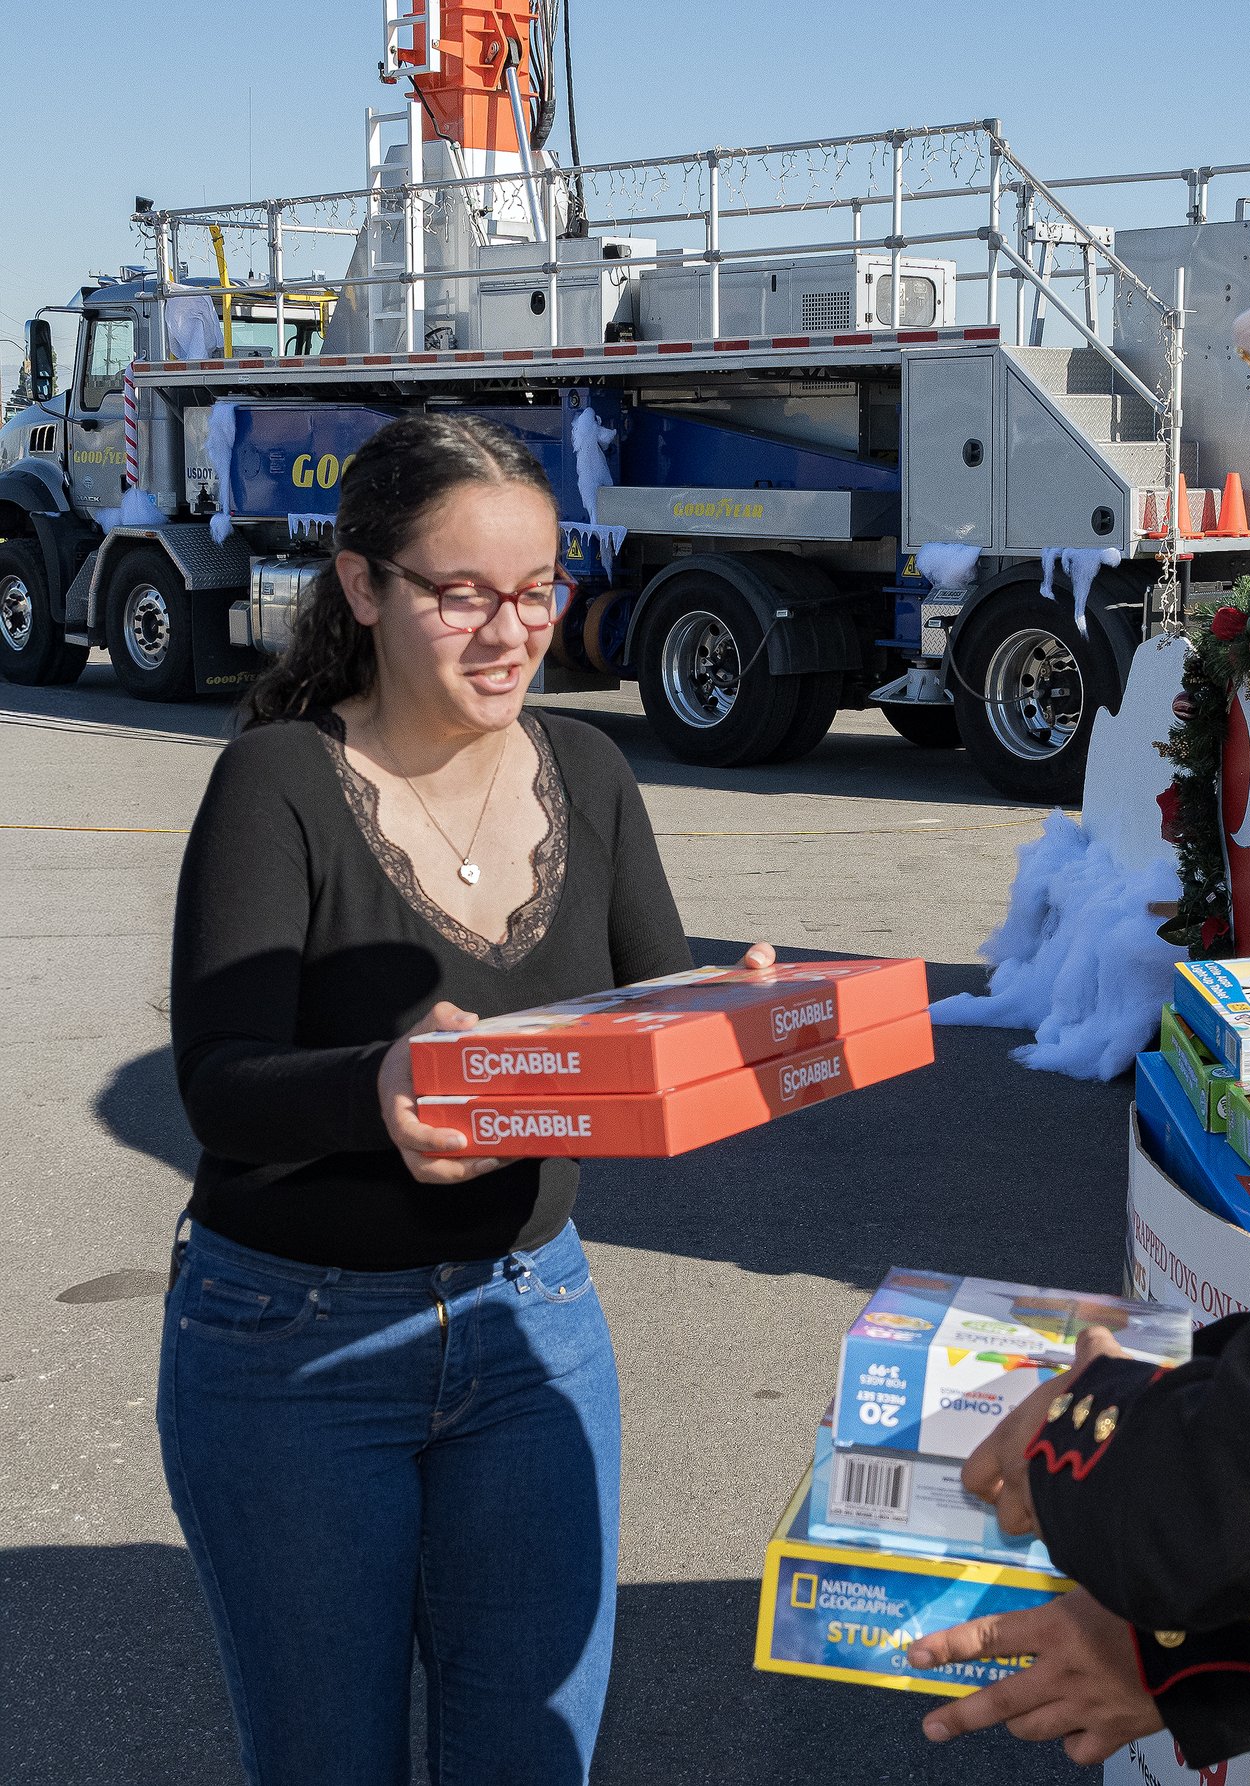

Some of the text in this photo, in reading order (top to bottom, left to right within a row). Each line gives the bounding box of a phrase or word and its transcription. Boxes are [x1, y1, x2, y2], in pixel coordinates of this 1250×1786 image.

[187, 467, 212, 480] USDOT
[673, 498, 764, 520] GOODYEAR
[774, 999, 834, 1034] SCRABBLE
[469, 1051, 581, 1076] SCRABBLE
[783, 1055, 840, 1093] SCRABBLE
[479, 1114, 592, 1138] SCRABBLE
[1169, 1251, 1198, 1303] TOYS
[860, 1374, 907, 1390] FOR AGES
[868, 1363, 900, 1379] 3-99
[856, 1390, 907, 1405] PIECE SET
[940, 1399, 1002, 1417] COMBO
[859, 1402, 899, 1427] 20
[821, 1578, 887, 1600] NATIONAL
[819, 1595, 905, 1618] GEOGRAPHIC
